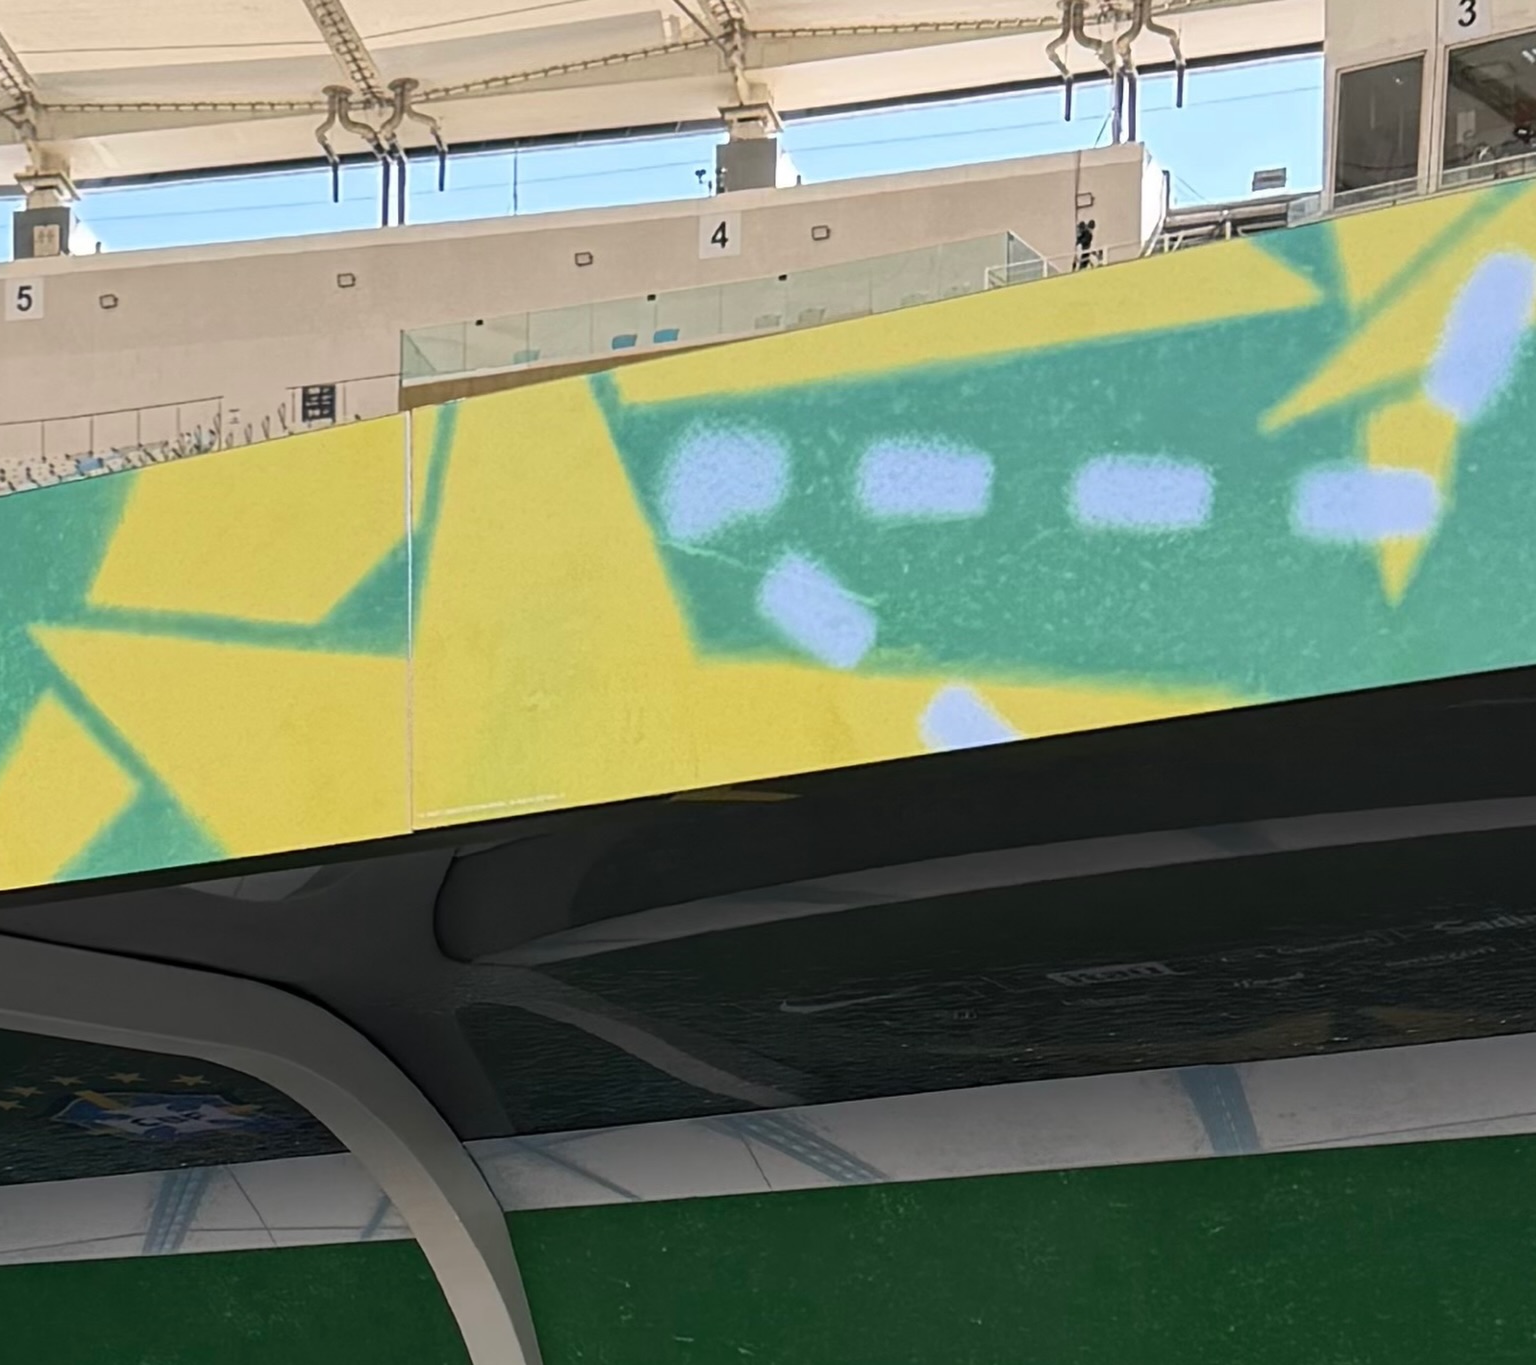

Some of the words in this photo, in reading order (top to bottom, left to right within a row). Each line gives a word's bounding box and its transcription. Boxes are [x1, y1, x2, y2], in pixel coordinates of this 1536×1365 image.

[1458, 0, 1476, 27] 3
[711, 220, 728, 249] 4
[16, 285, 32, 312] 5
